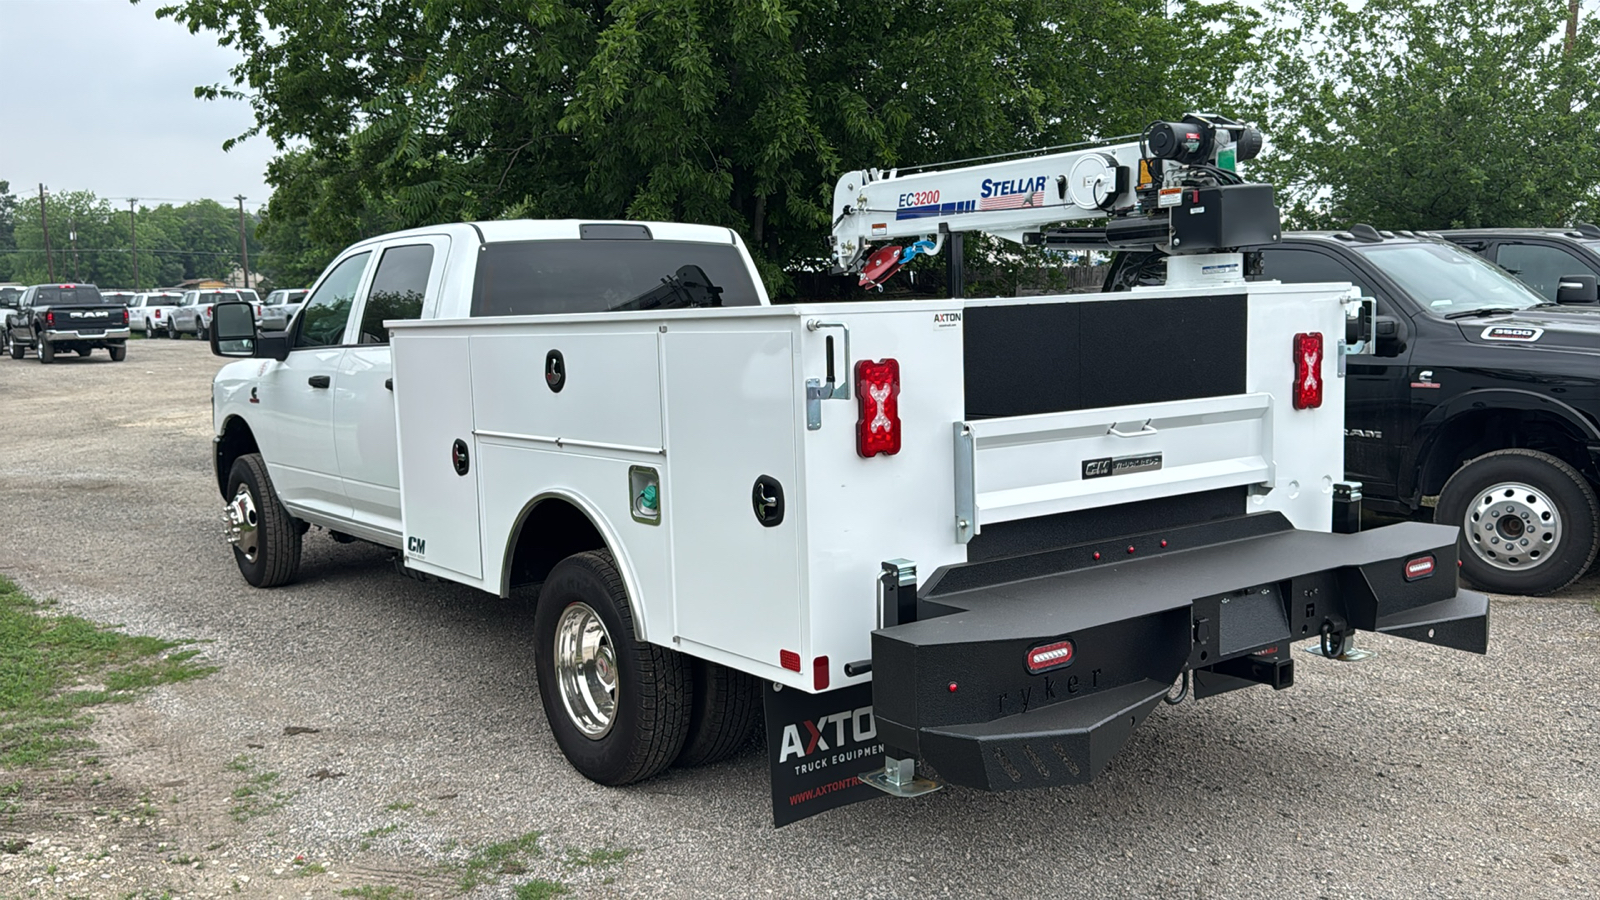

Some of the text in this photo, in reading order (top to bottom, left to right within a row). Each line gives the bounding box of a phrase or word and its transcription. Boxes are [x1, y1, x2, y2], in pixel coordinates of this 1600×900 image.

[980, 176, 1047, 198] STELLAR
[898, 190, 941, 208] EC3200
[70, 311, 109, 319] RAM
[934, 313, 961, 323] AXTON
[408, 536, 426, 555] CM
[998, 667, 1102, 714] ryker
[779, 705, 877, 763] AXTO
[794, 743, 885, 775] TRUCK EQUIPMEN
[789, 776, 863, 806] WWW.AXTONTR
